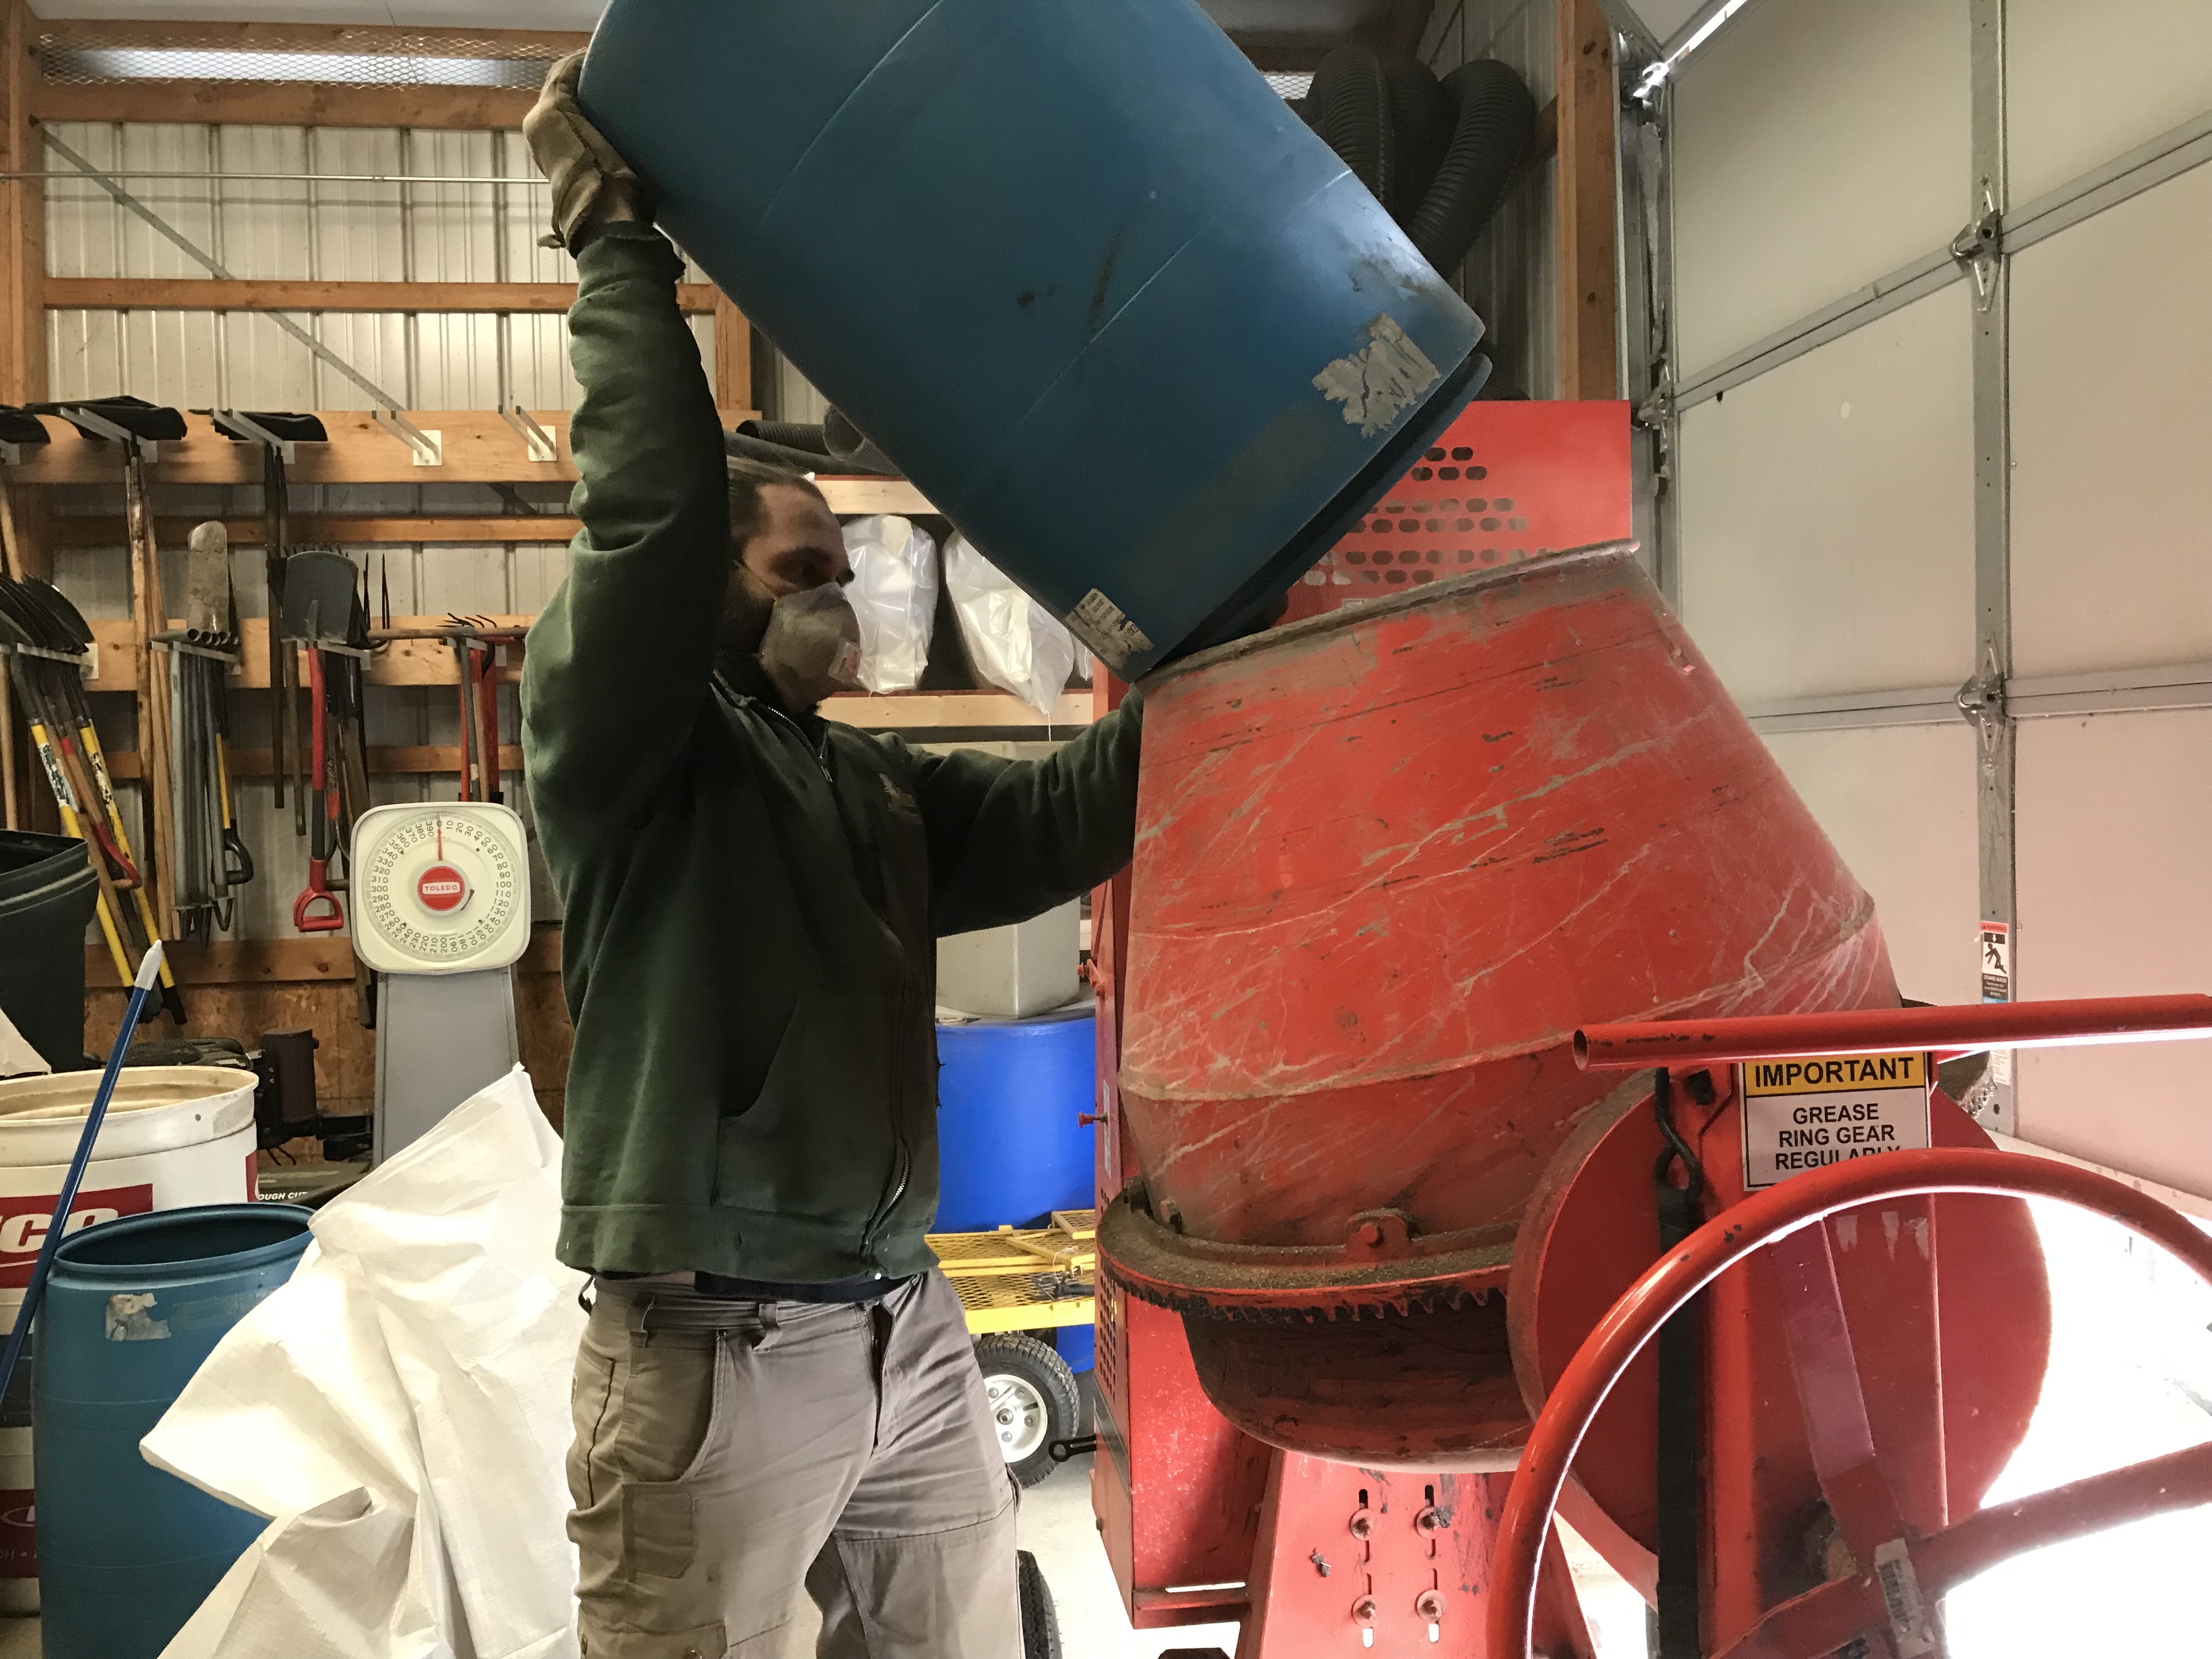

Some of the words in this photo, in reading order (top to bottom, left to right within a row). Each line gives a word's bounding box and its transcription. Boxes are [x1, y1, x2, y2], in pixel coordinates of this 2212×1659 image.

[416, 824, 426, 839] 380
[426, 821, 434, 837] 390
[446, 821, 453, 829] 10
[455, 823, 464, 833] 20
[465, 826, 473, 837] 30
[397, 833, 410, 847] 360
[405, 828, 417, 843] 370
[474, 831, 483, 841] 40
[481, 837, 491, 847] 50
[389, 840, 404, 854] 350
[487, 844, 498, 854] 60
[382, 848, 398, 860] 340
[493, 853, 504, 861] 70
[377, 856, 393, 867] 330
[496, 862, 507, 870] 80
[374, 866, 390, 875] 320
[373, 894, 389, 902] 290
[494, 899, 509, 907] 120
[375, 902, 391, 912] 280
[490, 906, 505, 916] 130
[380, 910, 395, 922] 270
[486, 913, 500, 926] 140
[385, 917, 400, 930] 260
[479, 921, 494, 933] 150
[392, 923, 405, 938] 250
[400, 929, 413, 944] 240
[473, 926, 486, 940] 160
[410, 933, 421, 948] 230
[420, 936, 429, 951] 220
[458, 935, 467, 950] 180
[466, 931, 477, 945] 170
[449, 938, 458, 952] 190
[1755, 1057, 1914, 1087] IMPORTANT
[1793, 1103, 1879, 1125] GREASE
[1779, 1128, 1829, 1147] RING
[1836, 1124, 1895, 1143] GEAR
